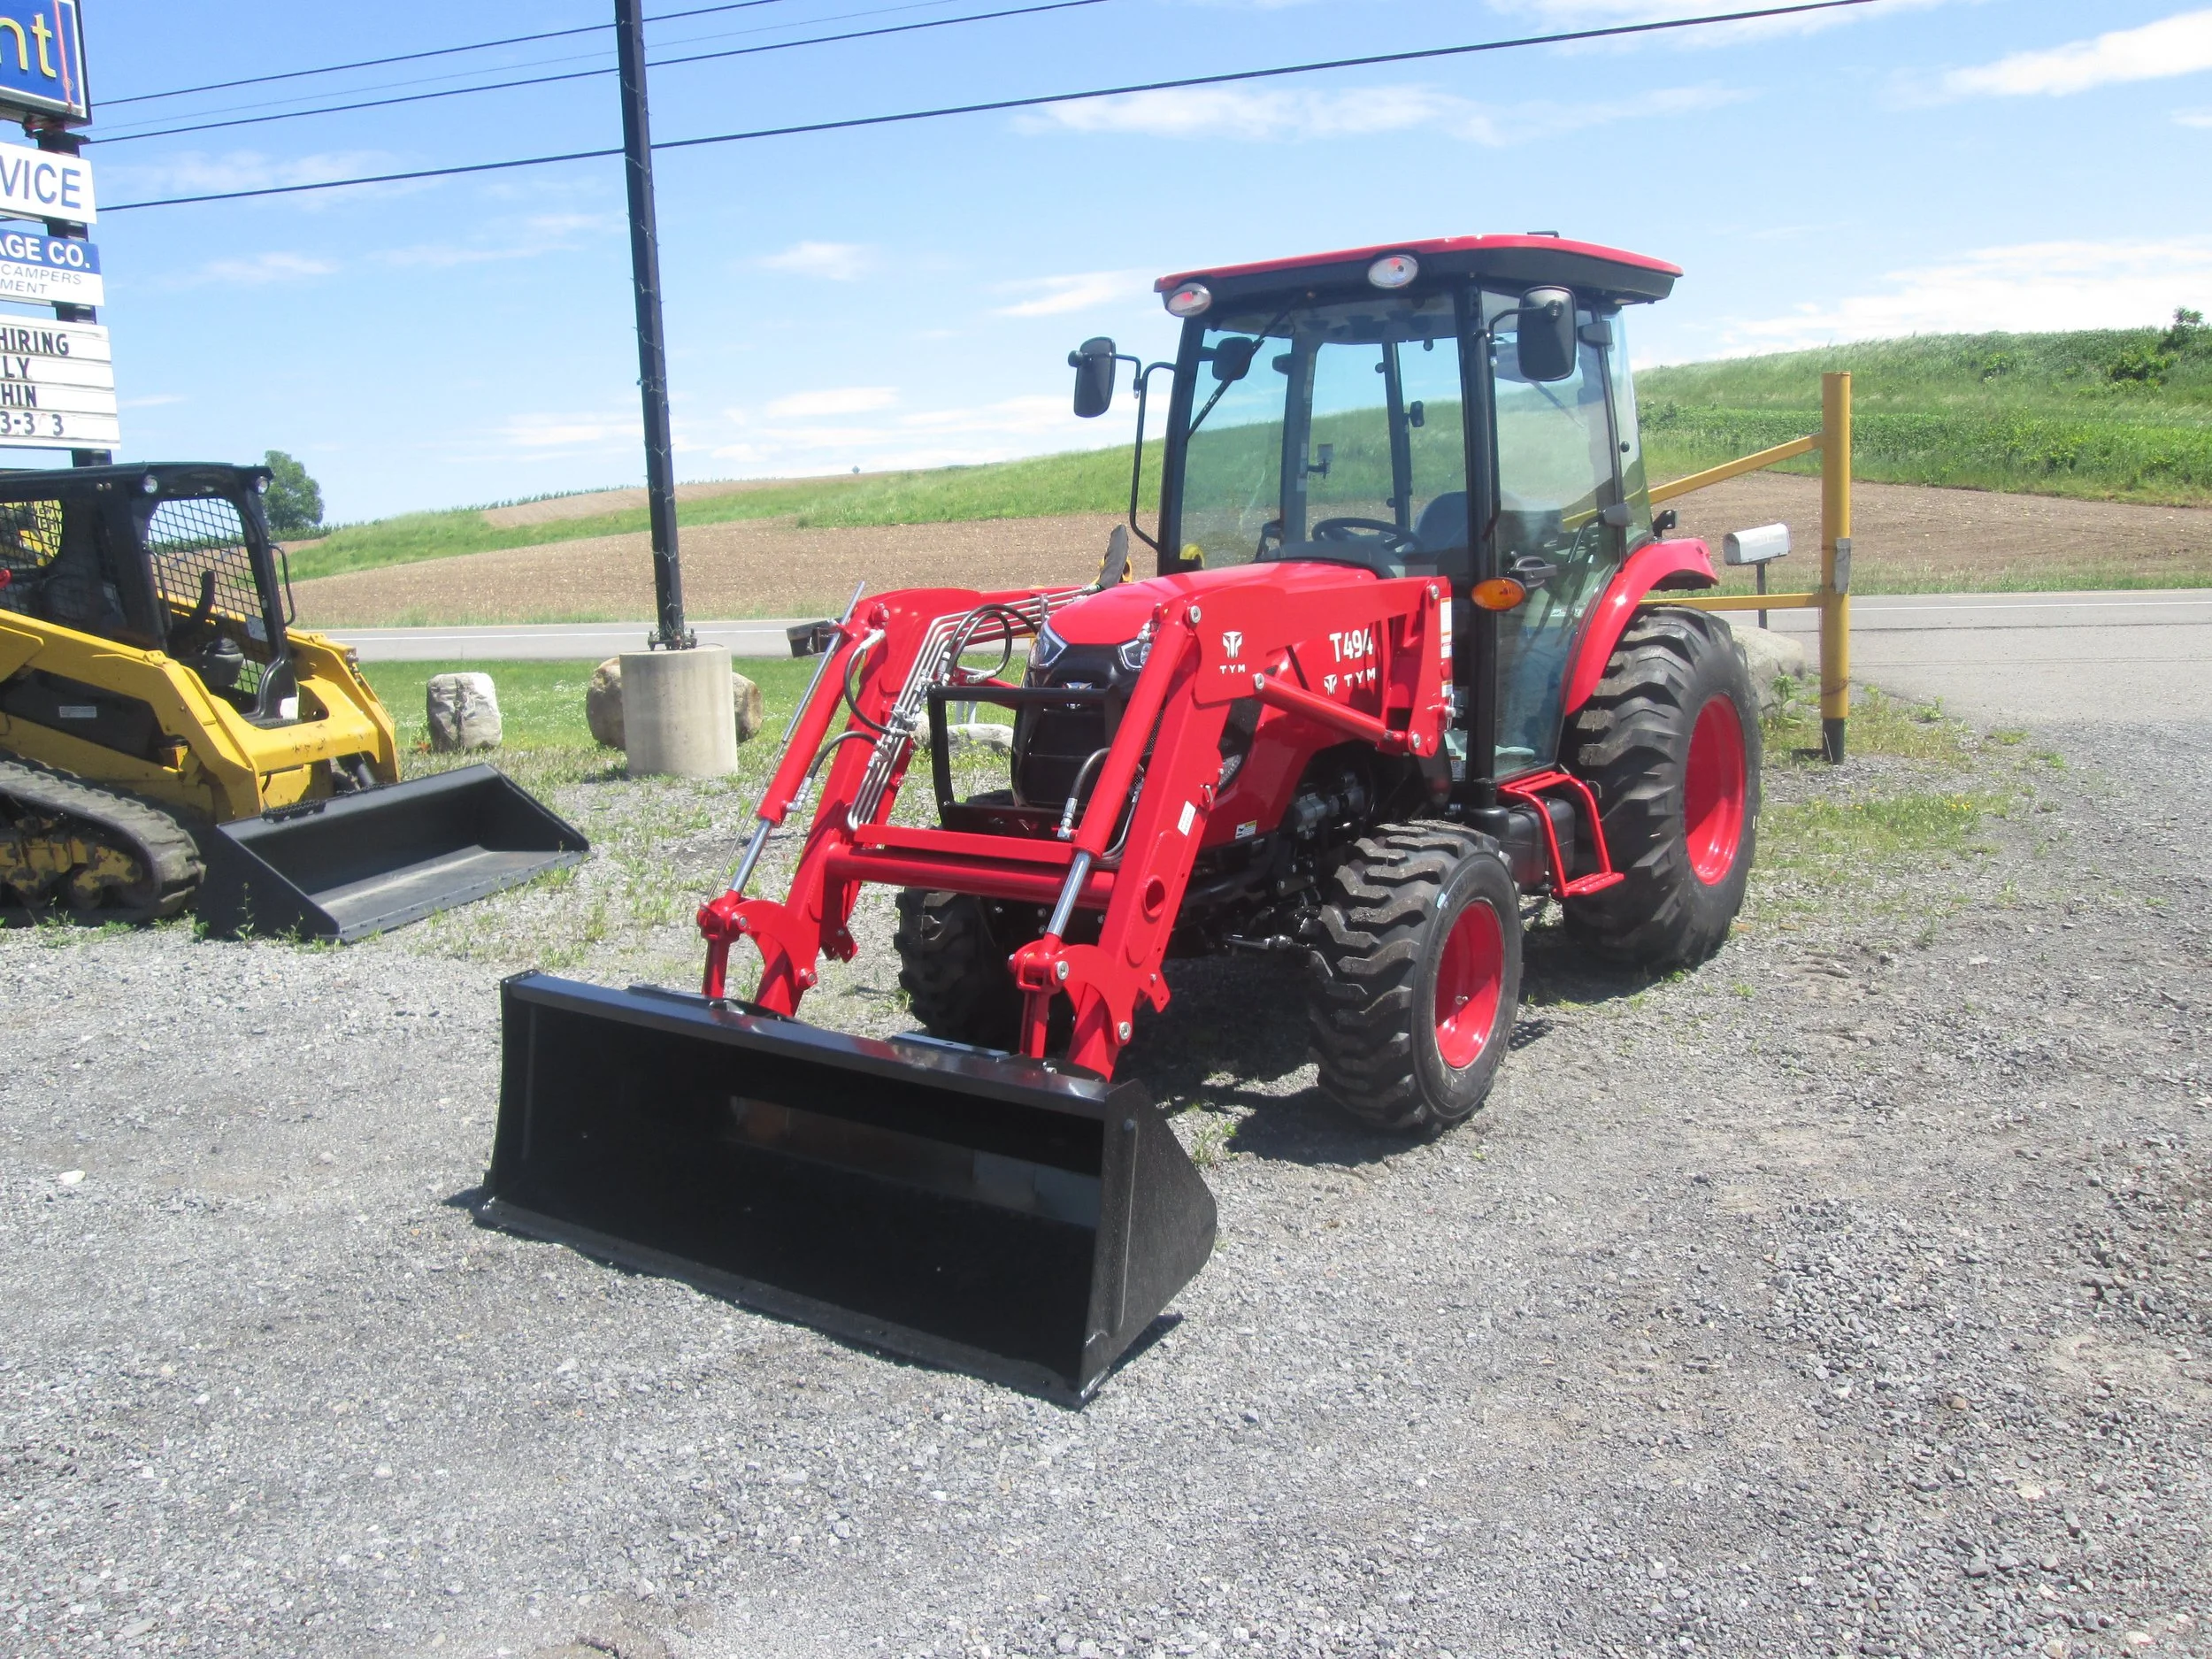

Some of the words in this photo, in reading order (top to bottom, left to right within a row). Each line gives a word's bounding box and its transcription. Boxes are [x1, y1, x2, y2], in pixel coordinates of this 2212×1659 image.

[0, 155, 81, 209] VICE
[49, 241, 90, 269] CO.
[0, 278, 48, 295] MENT
[1, 264, 81, 285] CAMPERS
[0, 327, 69, 356] HIRING
[3, 355, 30, 379] LY
[1, 383, 37, 408] HIN
[1329, 627, 1373, 663] T494
[1219, 664, 1246, 674] TYM
[1343, 667, 1376, 687] TYM
